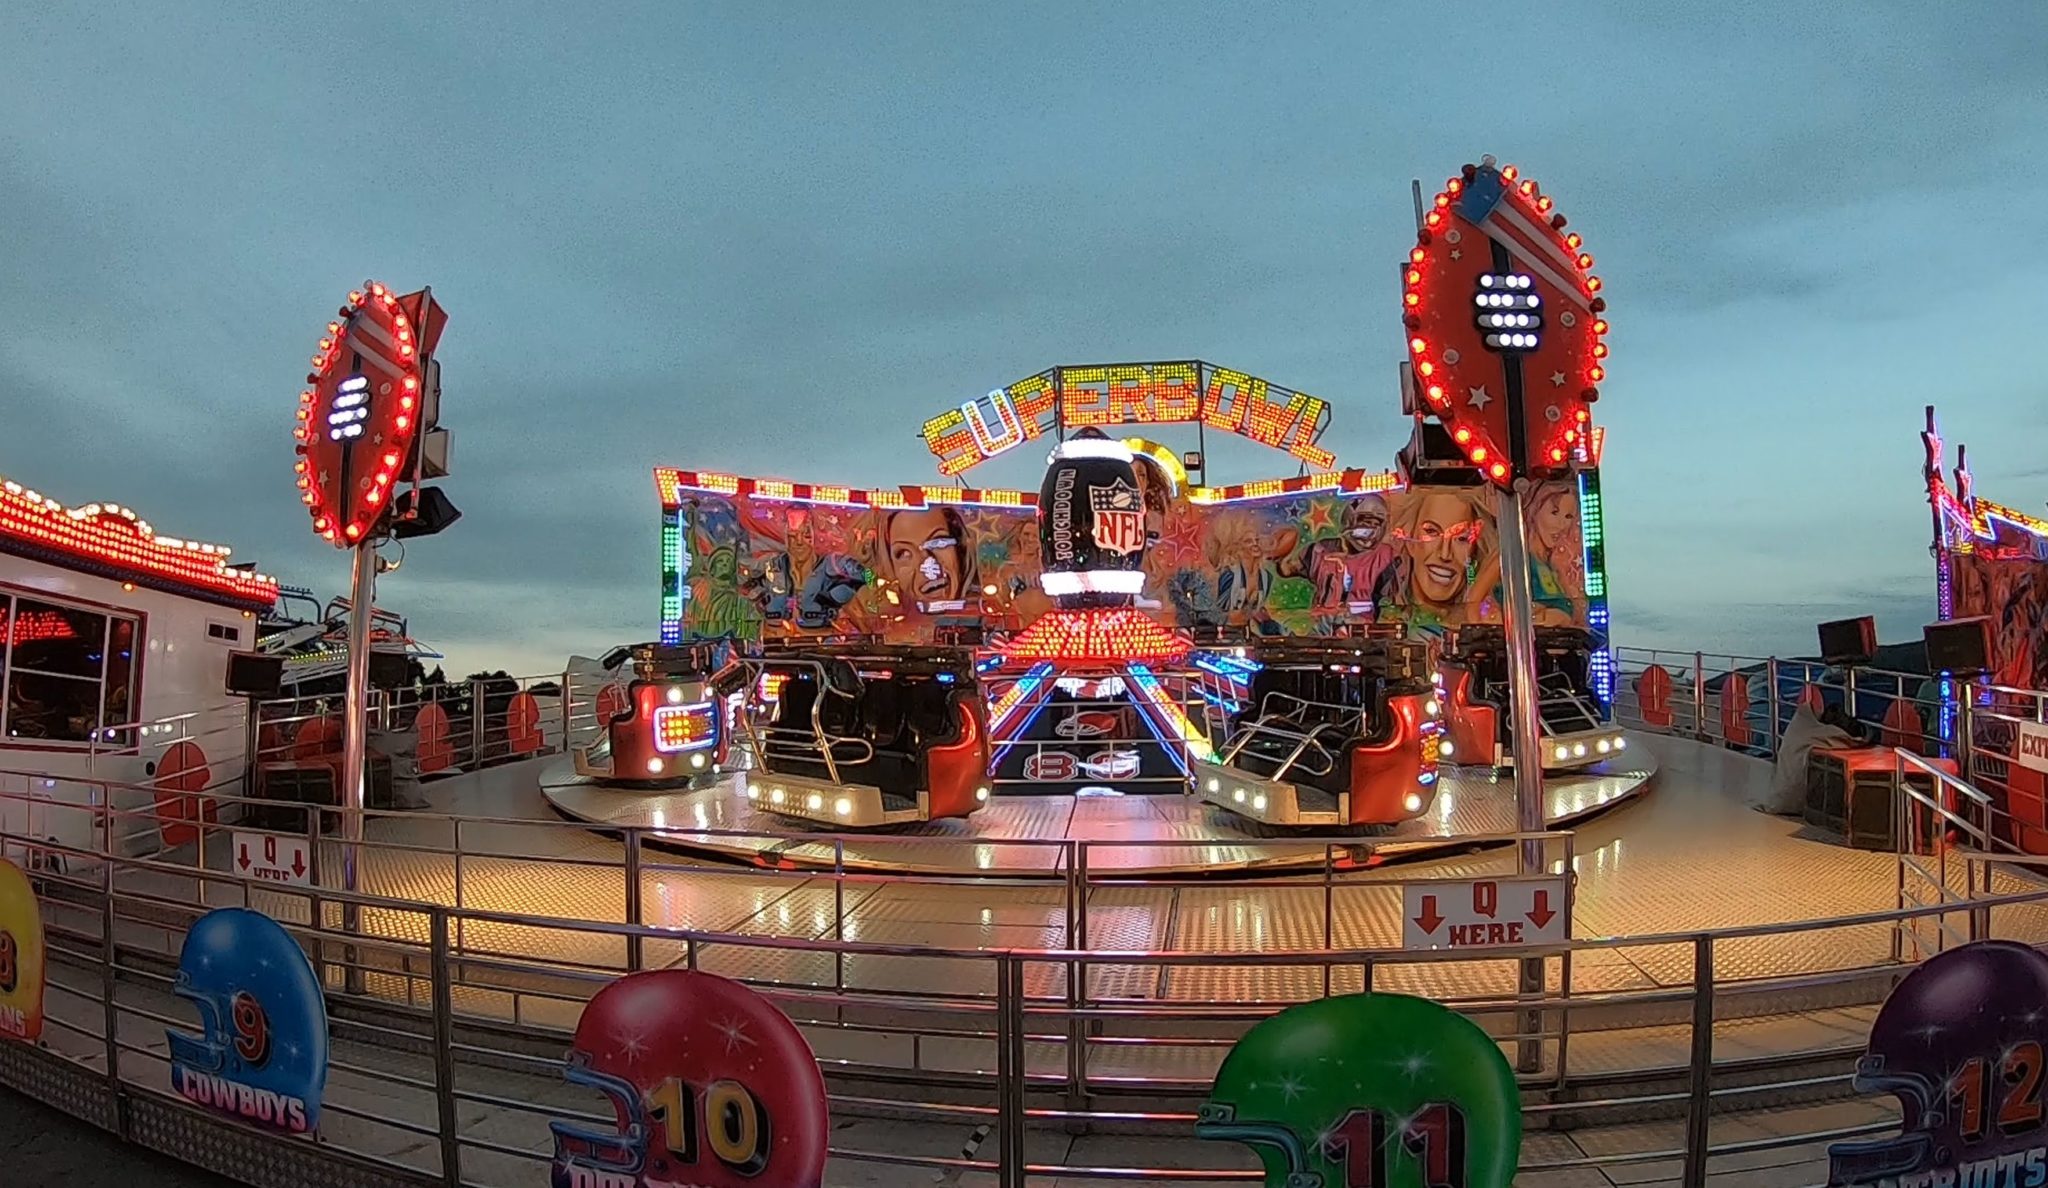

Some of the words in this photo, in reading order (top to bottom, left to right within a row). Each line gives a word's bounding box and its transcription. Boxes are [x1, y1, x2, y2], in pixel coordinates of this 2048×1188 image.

[920, 363, 1337, 477] SUPERBOWL
[1053, 468, 1077, 561] TOUCHDOWN
[1097, 511, 1143, 550] NFL
[264, 835, 277, 866] Q
[1447, 921, 1525, 946] HERE
[1472, 880, 1498, 918] Q
[231, 990, 271, 1070] 9
[181, 1067, 307, 1132] COWBOYS
[643, 1077, 771, 1178] 10
[1948, 1040, 2048, 1146] 12
[1320, 1102, 1468, 1188] 11
